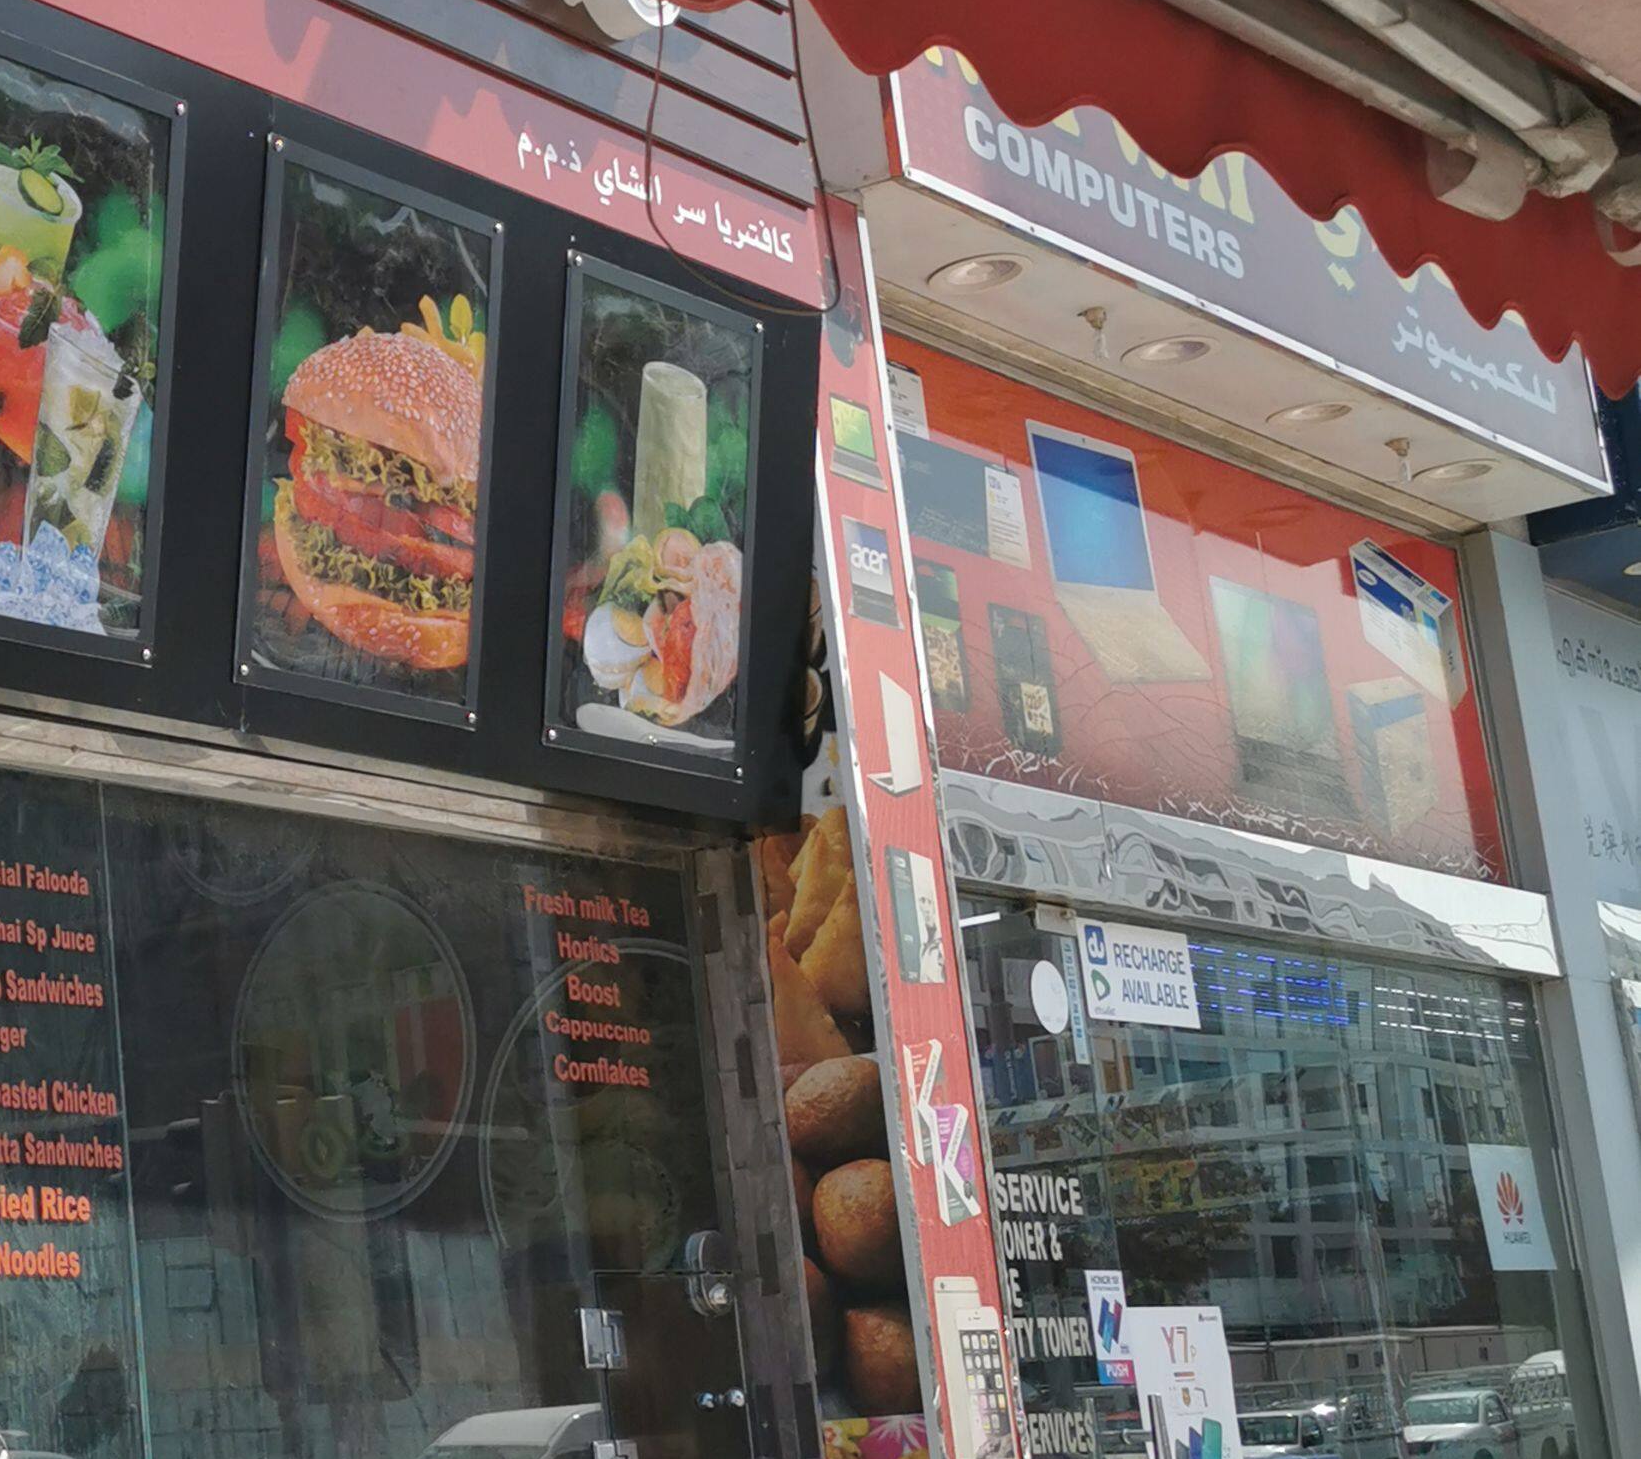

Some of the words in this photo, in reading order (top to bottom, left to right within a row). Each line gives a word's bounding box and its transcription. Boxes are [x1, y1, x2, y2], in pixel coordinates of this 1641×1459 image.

[594, 157, 662, 205] الشاي
[964, 105, 1245, 279] COMPUTERS
[672, 202, 707, 225] سر
[714, 201, 794, 263] كافتريا
[850, 542, 888, 576] acer
[25, 863, 90, 897] Falooda
[521, 884, 575, 917] Fresh
[580, 893, 617, 924] milk
[619, 897, 650, 927] Tea
[25, 919, 48, 953] Sp
[51, 924, 96, 953] Juice
[1113, 942, 1187, 975] RECHARGE
[6, 969, 104, 1008] Sandwiches
[566, 975, 621, 1007] Boost
[1122, 978, 1190, 1011] AVAILABLE
[545, 1010, 651, 1045] Cappuccino
[554, 1053, 651, 1088] Cornflakes
[52, 1079, 117, 1117] Chicken
[25, 1132, 123, 1170] Sandwiches
[40, 1185, 92, 1224] Rice
[994, 1171, 1084, 1216] SERVICE
[1000, 1220, 1048, 1261] ONER
[1037, 1317, 1093, 1357] TONER
